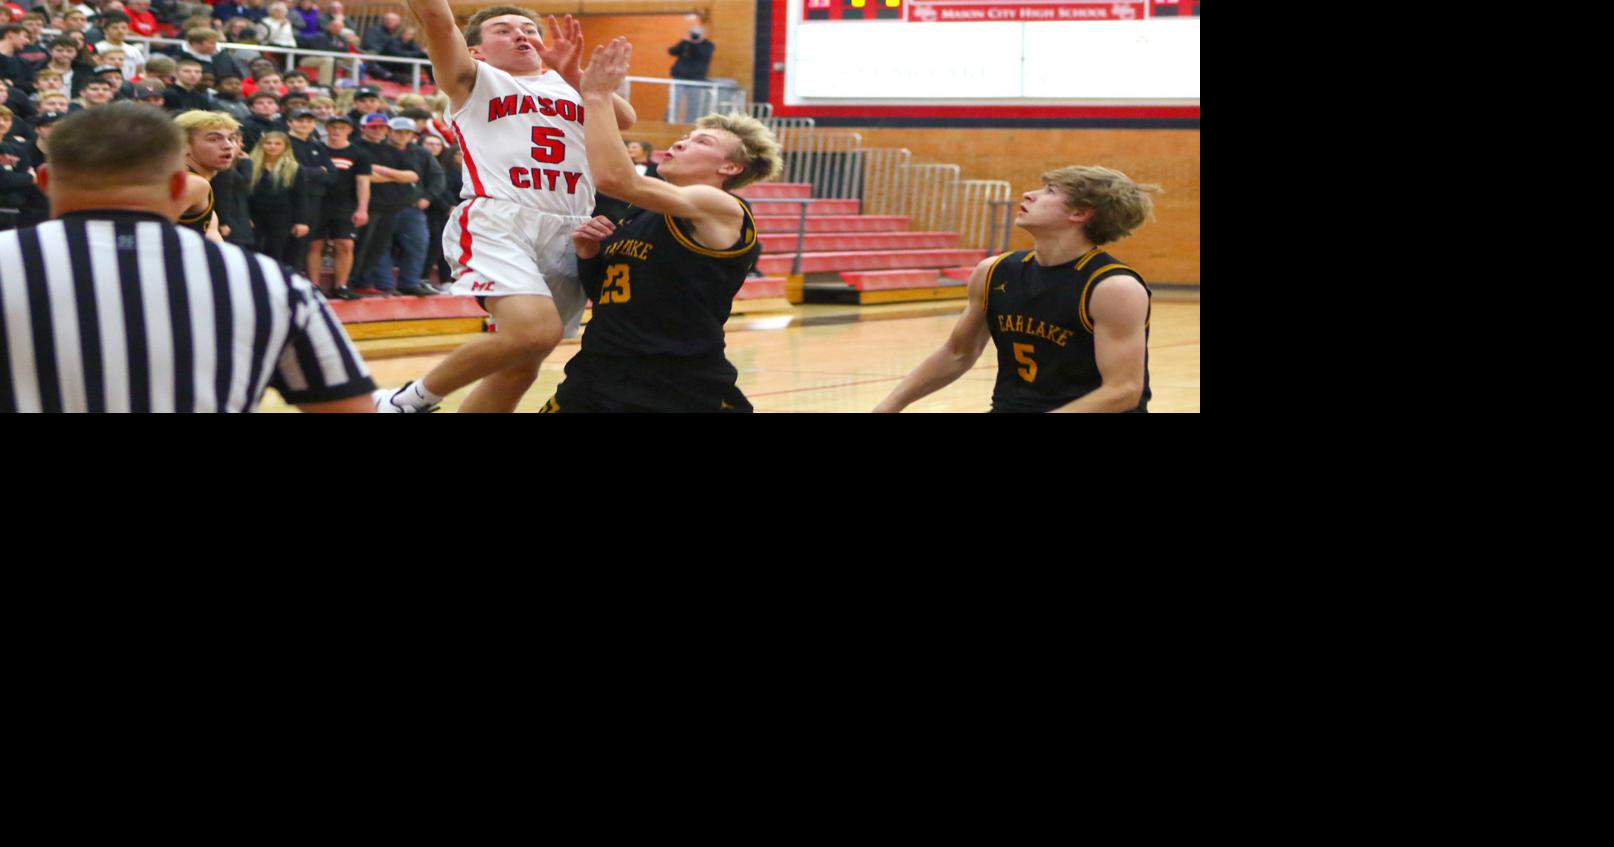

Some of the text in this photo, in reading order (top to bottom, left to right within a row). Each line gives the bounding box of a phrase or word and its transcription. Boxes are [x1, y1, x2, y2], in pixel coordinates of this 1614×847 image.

[531, 125, 565, 164] 5
[509, 166, 582, 194] CITY
[599, 264, 631, 304] 23
[1012, 342, 1038, 383] 5
